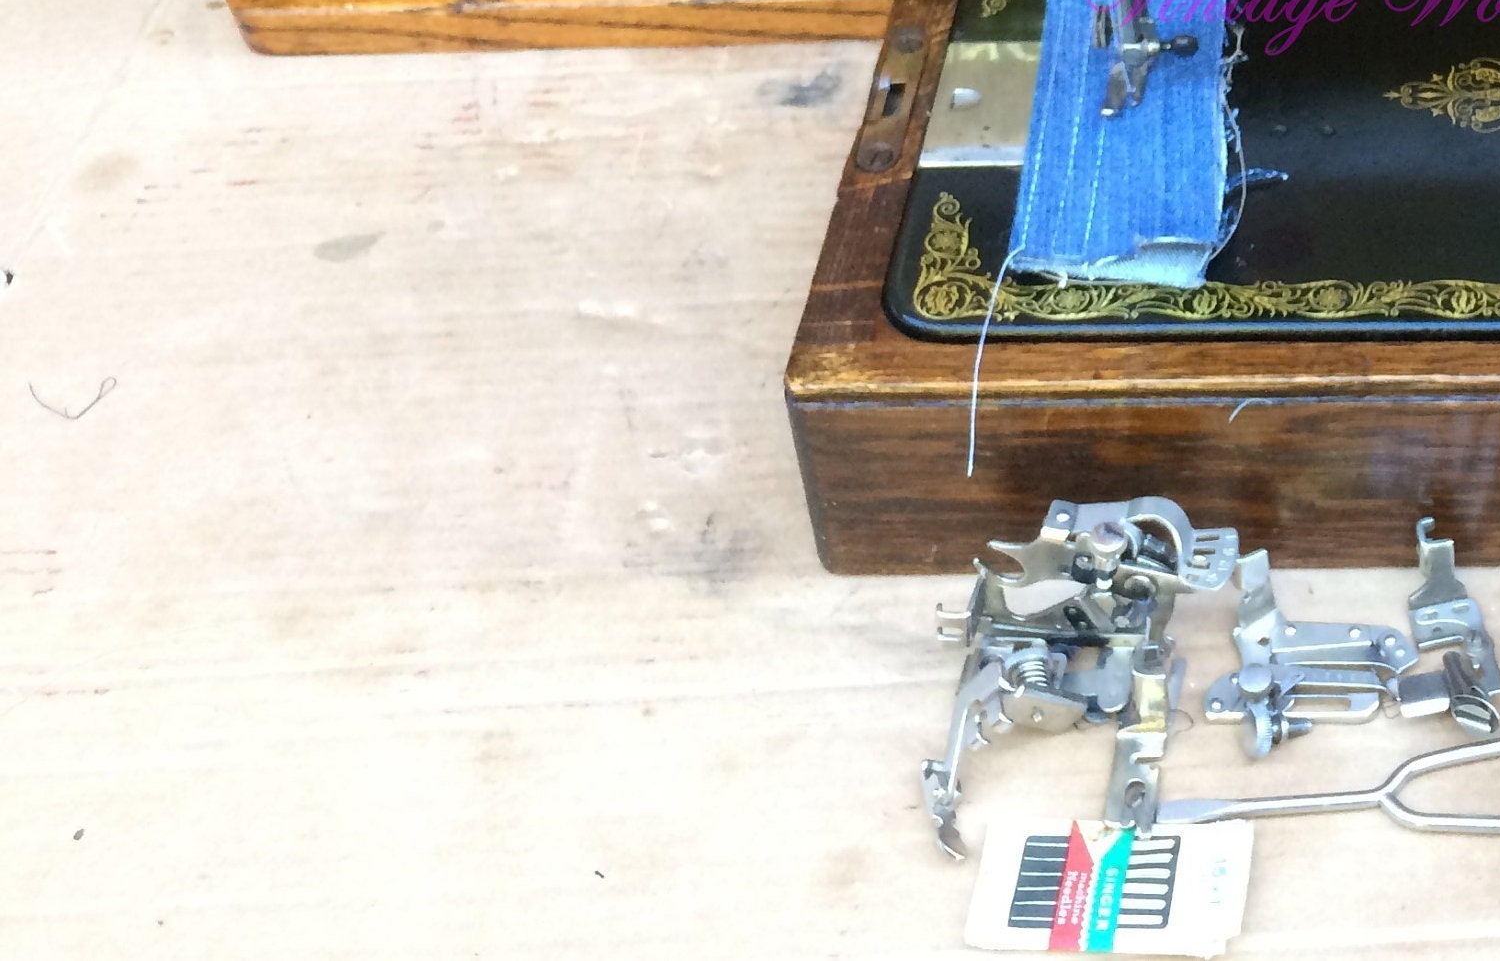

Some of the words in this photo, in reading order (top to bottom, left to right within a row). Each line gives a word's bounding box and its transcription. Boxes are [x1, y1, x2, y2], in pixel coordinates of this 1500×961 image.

[1057, 870, 1079, 925] Needles
[1071, 871, 1088, 925] machine
[1096, 867, 1120, 931] SINGER
